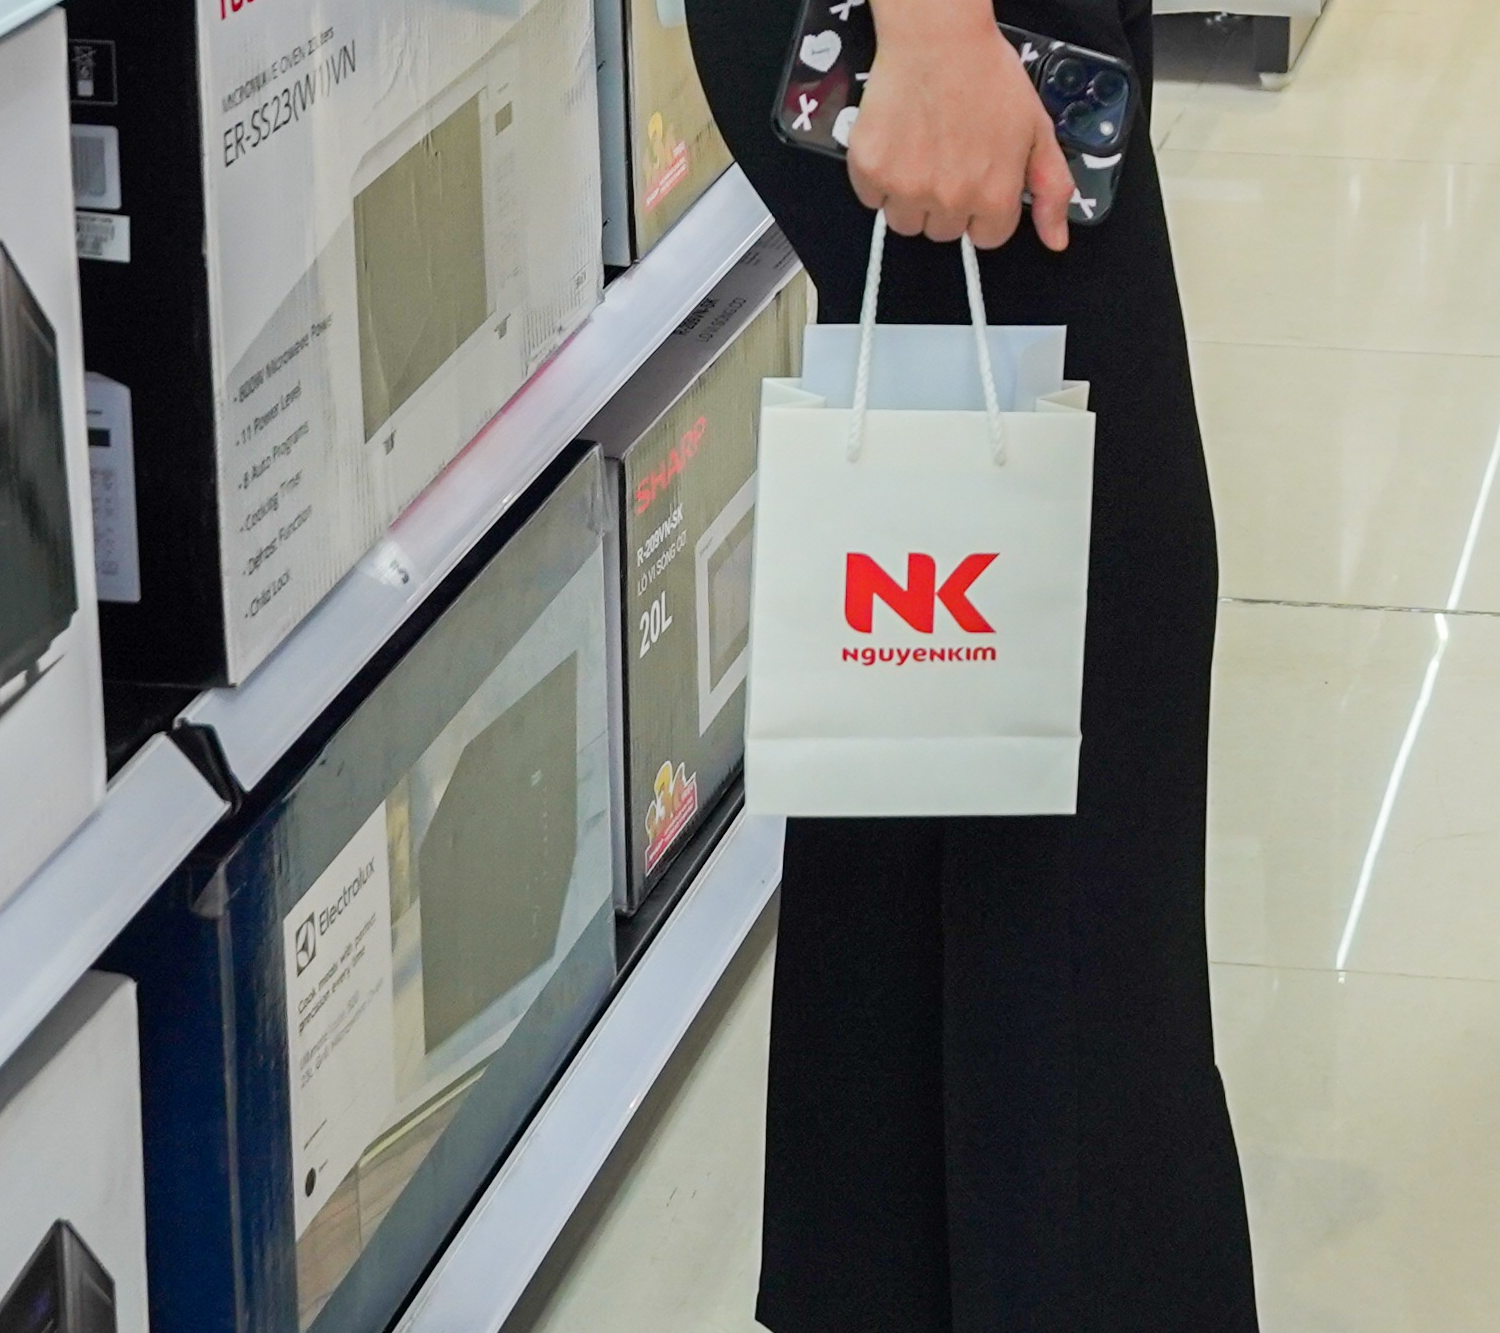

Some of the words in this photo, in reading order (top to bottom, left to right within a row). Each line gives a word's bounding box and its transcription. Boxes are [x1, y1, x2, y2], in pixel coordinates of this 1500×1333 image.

[635, 415, 710, 515] SHARP
[638, 591, 674, 660] 20L
[845, 552, 1000, 634] NK
[319, 855, 376, 937] Electrolux
